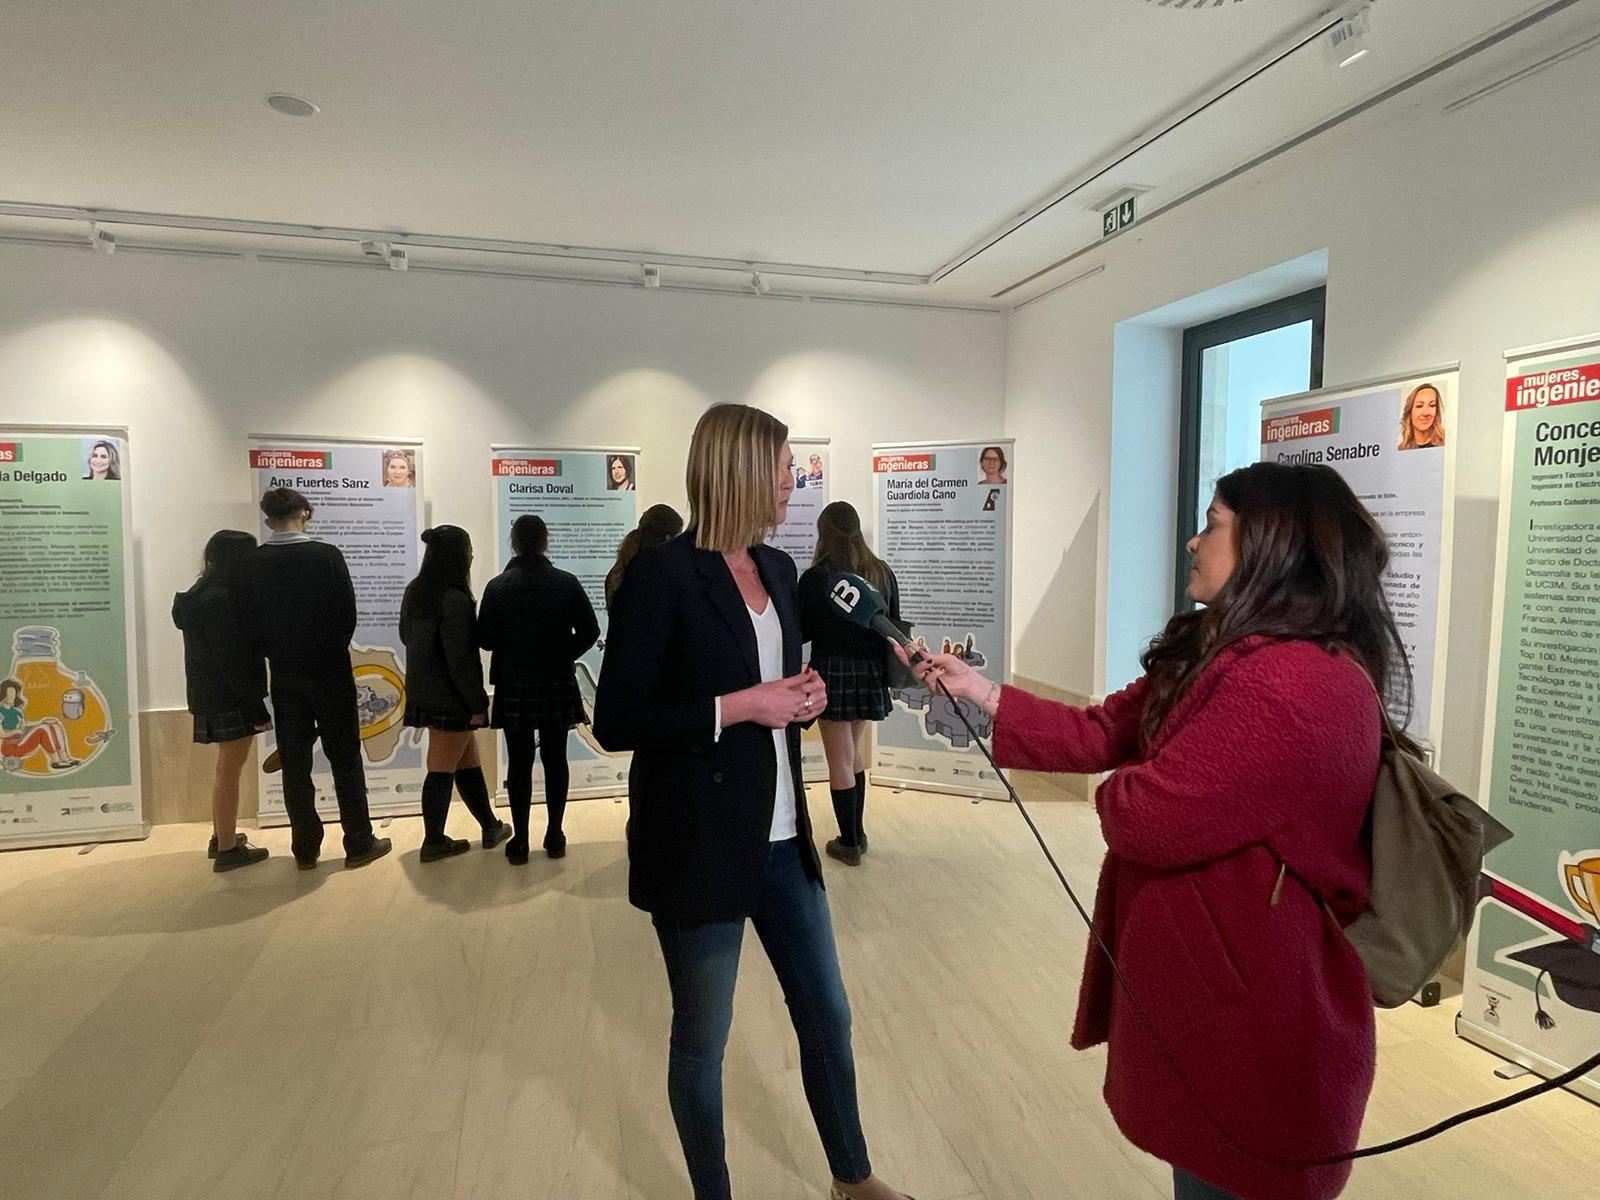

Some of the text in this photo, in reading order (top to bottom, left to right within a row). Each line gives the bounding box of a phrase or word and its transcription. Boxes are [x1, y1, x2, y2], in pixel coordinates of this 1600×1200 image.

[1524, 369, 1580, 388] mujeres
[1516, 376, 1600, 408] ingenie
[1267, 419, 1330, 442] ingenieras
[1278, 443, 1380, 465] Carolina Senabre
[1534, 443, 1600, 468] Monje
[258, 456, 323, 468] ingenieras
[878, 460, 928, 473] ingenieras
[499, 464, 554, 476] ingenieras
[14, 470, 67, 484] Delgado
[270, 476, 370, 489] Ana Fuertes Sanz
[887, 478, 968, 488] María del Carmen
[510, 483, 574, 494] Clarisa Doval
[887, 490, 956, 500] Guardiola Cano
[1530, 519, 1594, 532] Investigadora
[1528, 534, 1582, 542] Universidad
[1528, 546, 1582, 554] Universidad
[1571, 582, 1590, 590] Sus
[1530, 627, 1578, 638] desarrollo
[1520, 638, 1597, 654] Su investigación
[1520, 650, 1598, 666] Top 100 Mujeres
[1532, 686, 1583, 700] Excelencia
[1516, 695, 1548, 706] Premio
[1554, 700, 1580, 712] Mujer
[1548, 714, 1573, 722] entre
[1514, 719, 1524, 728] Es
[1530, 724, 1546, 732] una
[1512, 754, 1534, 764] entre
[1556, 762, 1574, 772] que
[1526, 768, 1550, 778] radio
[1538, 780, 1550, 790] Ha
[1554, 784, 1598, 801] trabajado
